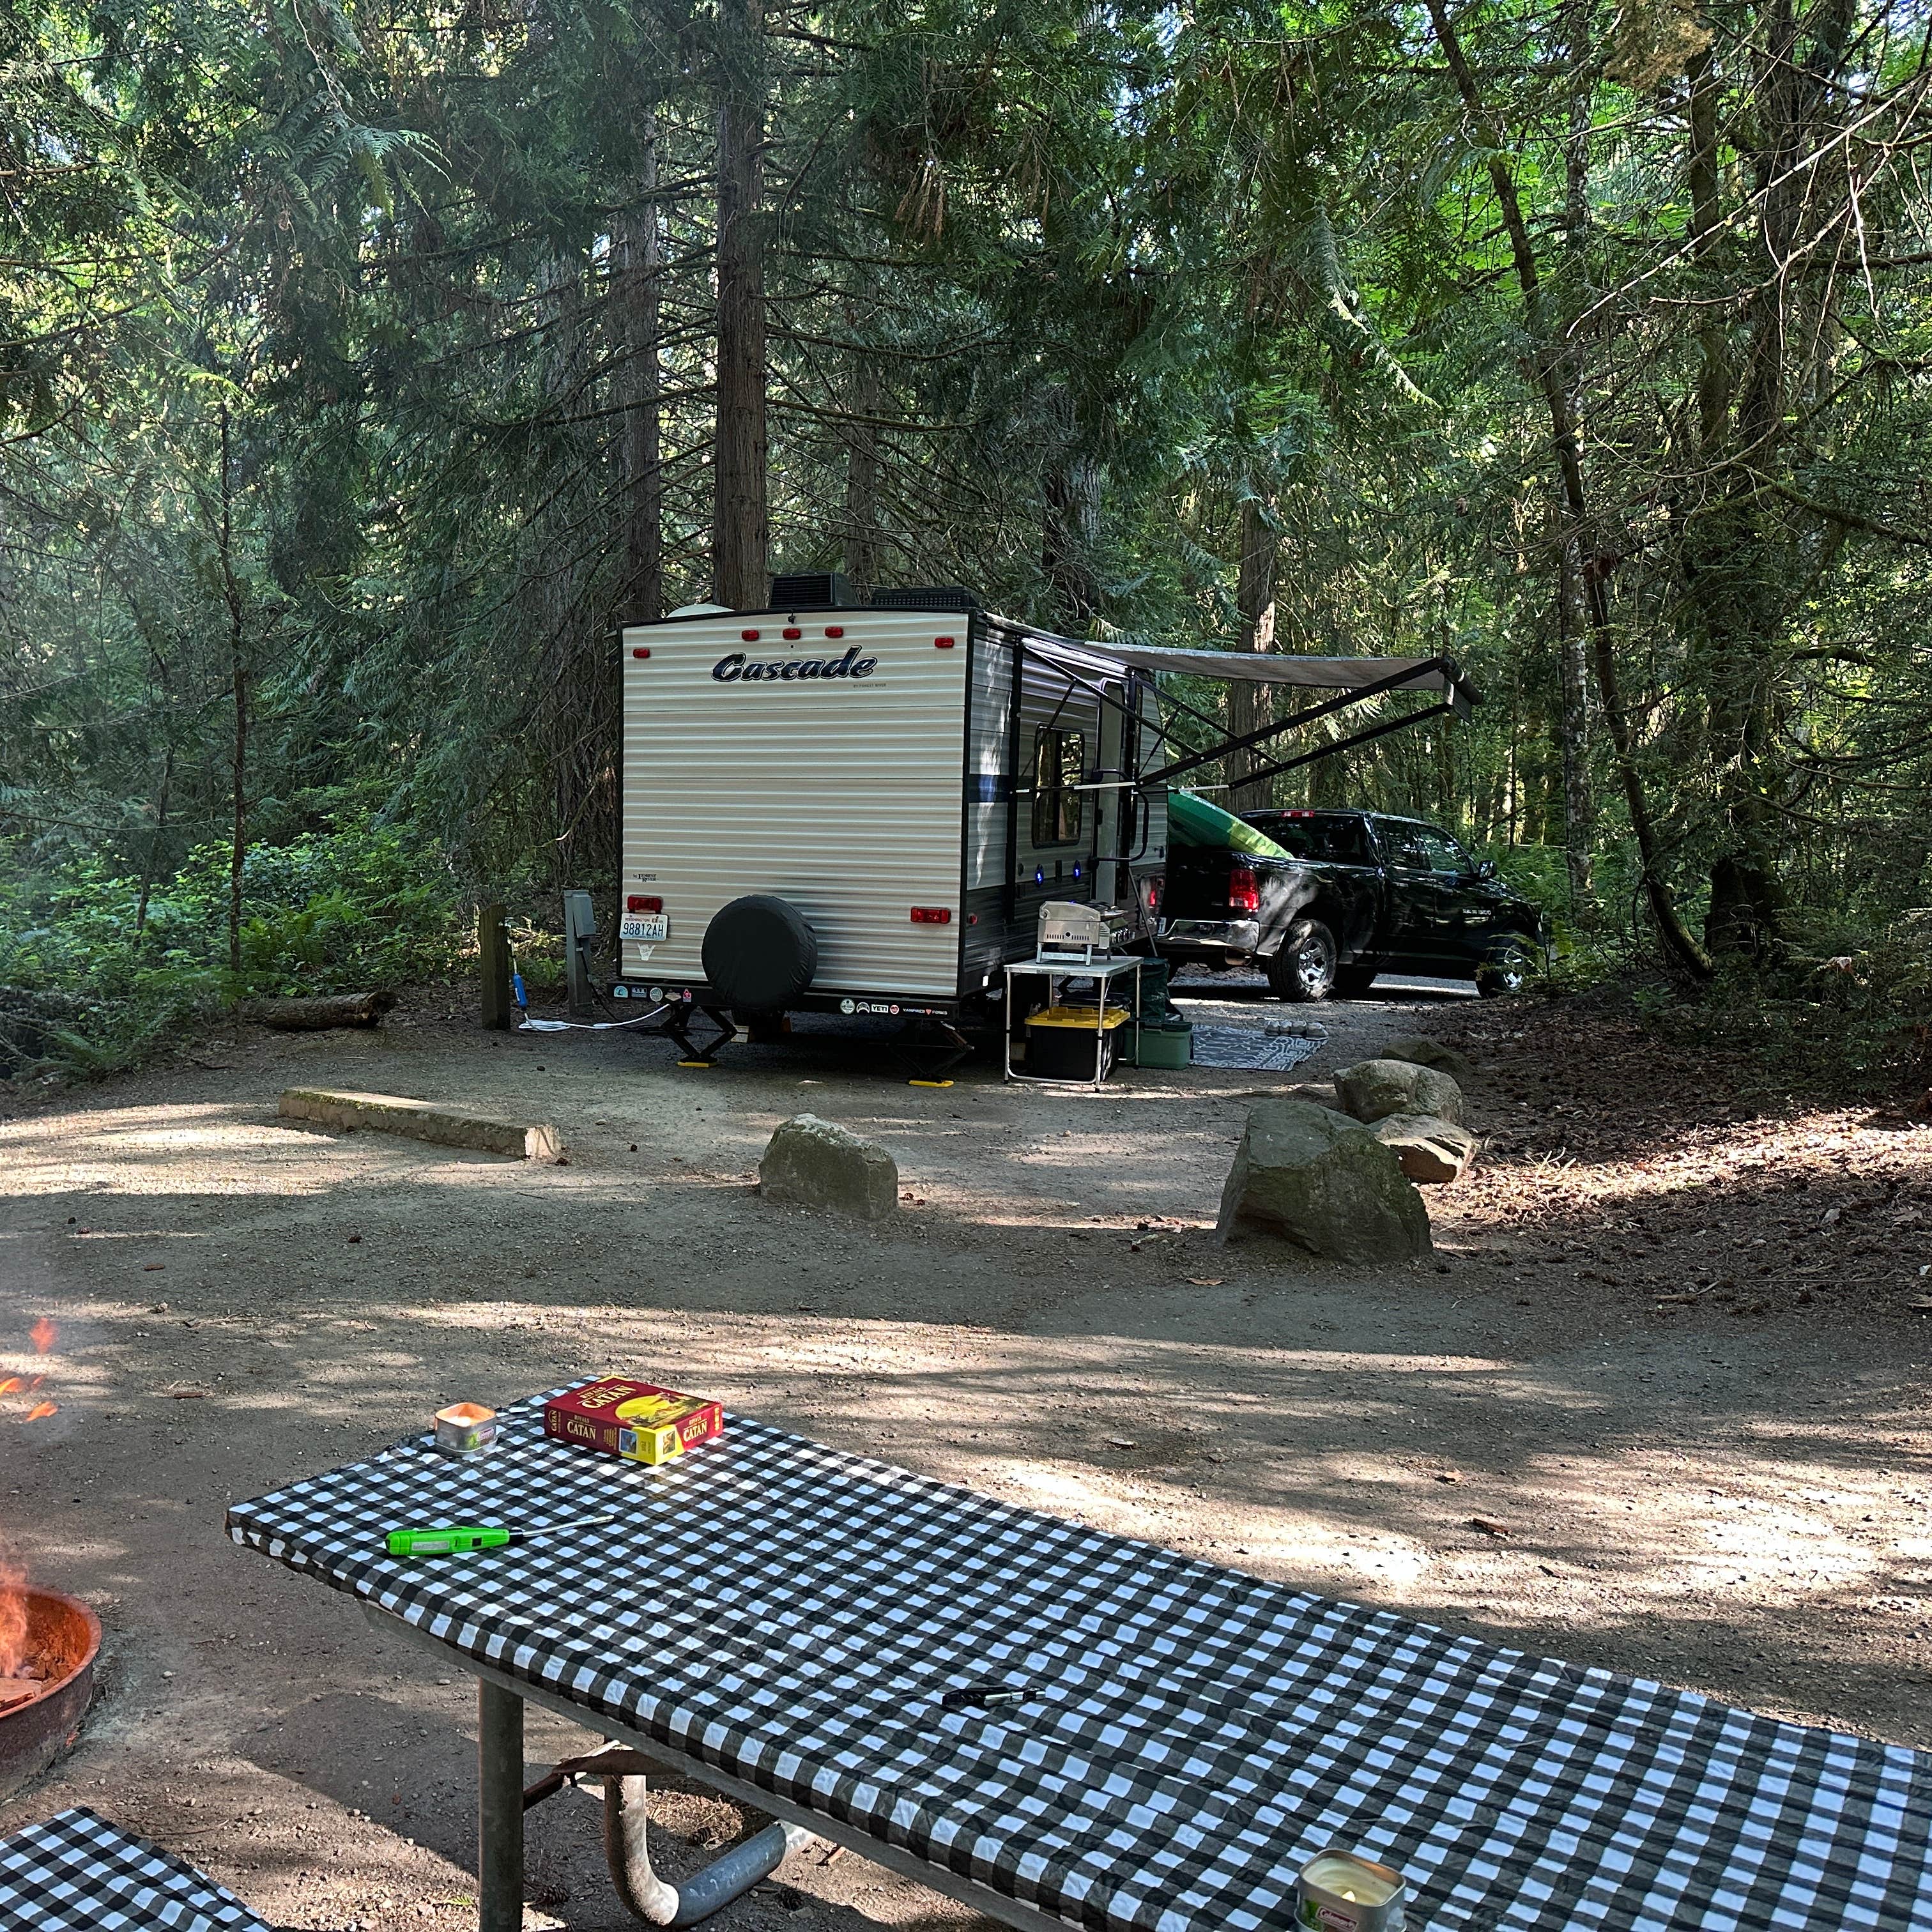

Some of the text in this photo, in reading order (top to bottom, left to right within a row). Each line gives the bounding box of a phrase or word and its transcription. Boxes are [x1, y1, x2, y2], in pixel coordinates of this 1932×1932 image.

[711, 645, 878, 682] Cascade
[623, 922, 664, 937] 98812AH
[579, 1386, 606, 1399] RIVALS
[582, 1385, 636, 1409] CATAN
[574, 1414, 590, 1423] RIVALS
[567, 1421, 597, 1441] CATAN
[683, 1421, 707, 1442] CATAN
